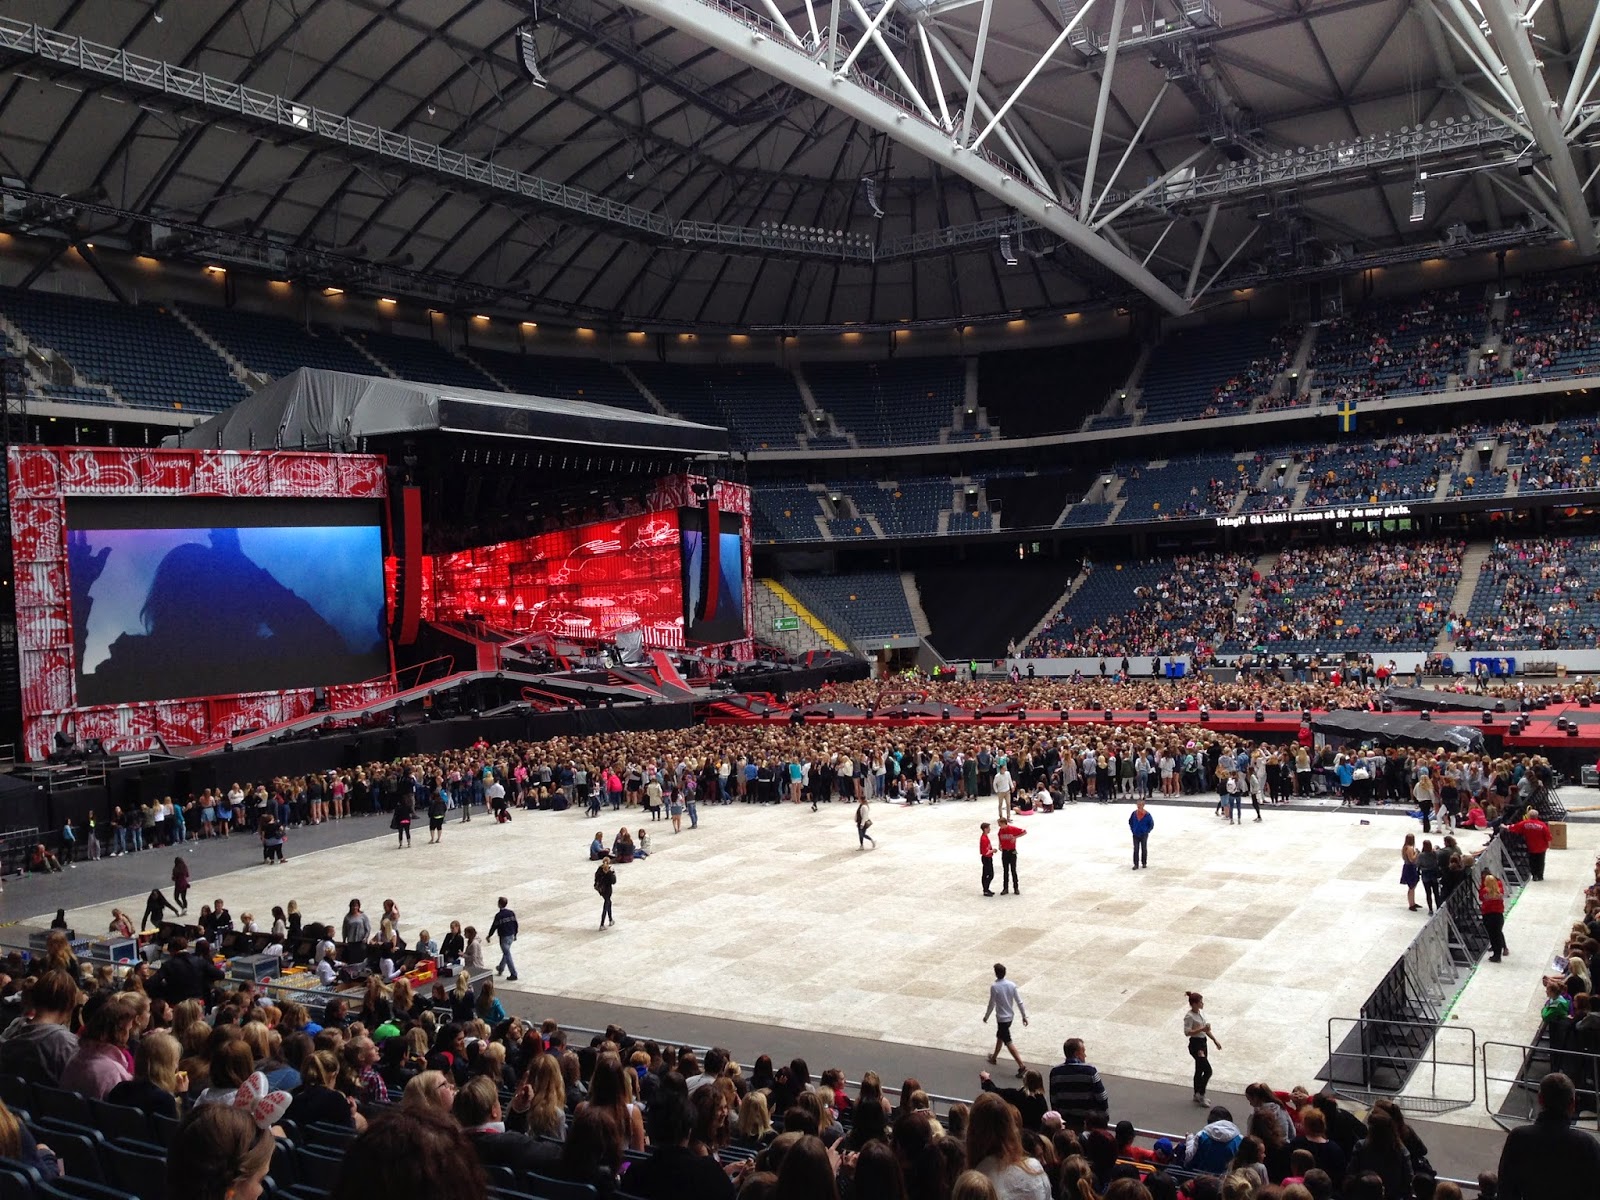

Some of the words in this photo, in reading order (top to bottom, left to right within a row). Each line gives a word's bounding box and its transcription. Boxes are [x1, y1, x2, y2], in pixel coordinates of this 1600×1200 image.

[1216, 515, 1247, 528] Trångt?
[1250, 515, 1261, 524] Gå
[1263, 513, 1287, 523] bakåt
[1293, 512, 1323, 521] arenan
[1324, 510, 1335, 519] så
[1352, 508, 1363, 517] du
[1365, 507, 1383, 516] mer
[1384, 504, 1411, 517] plats.
